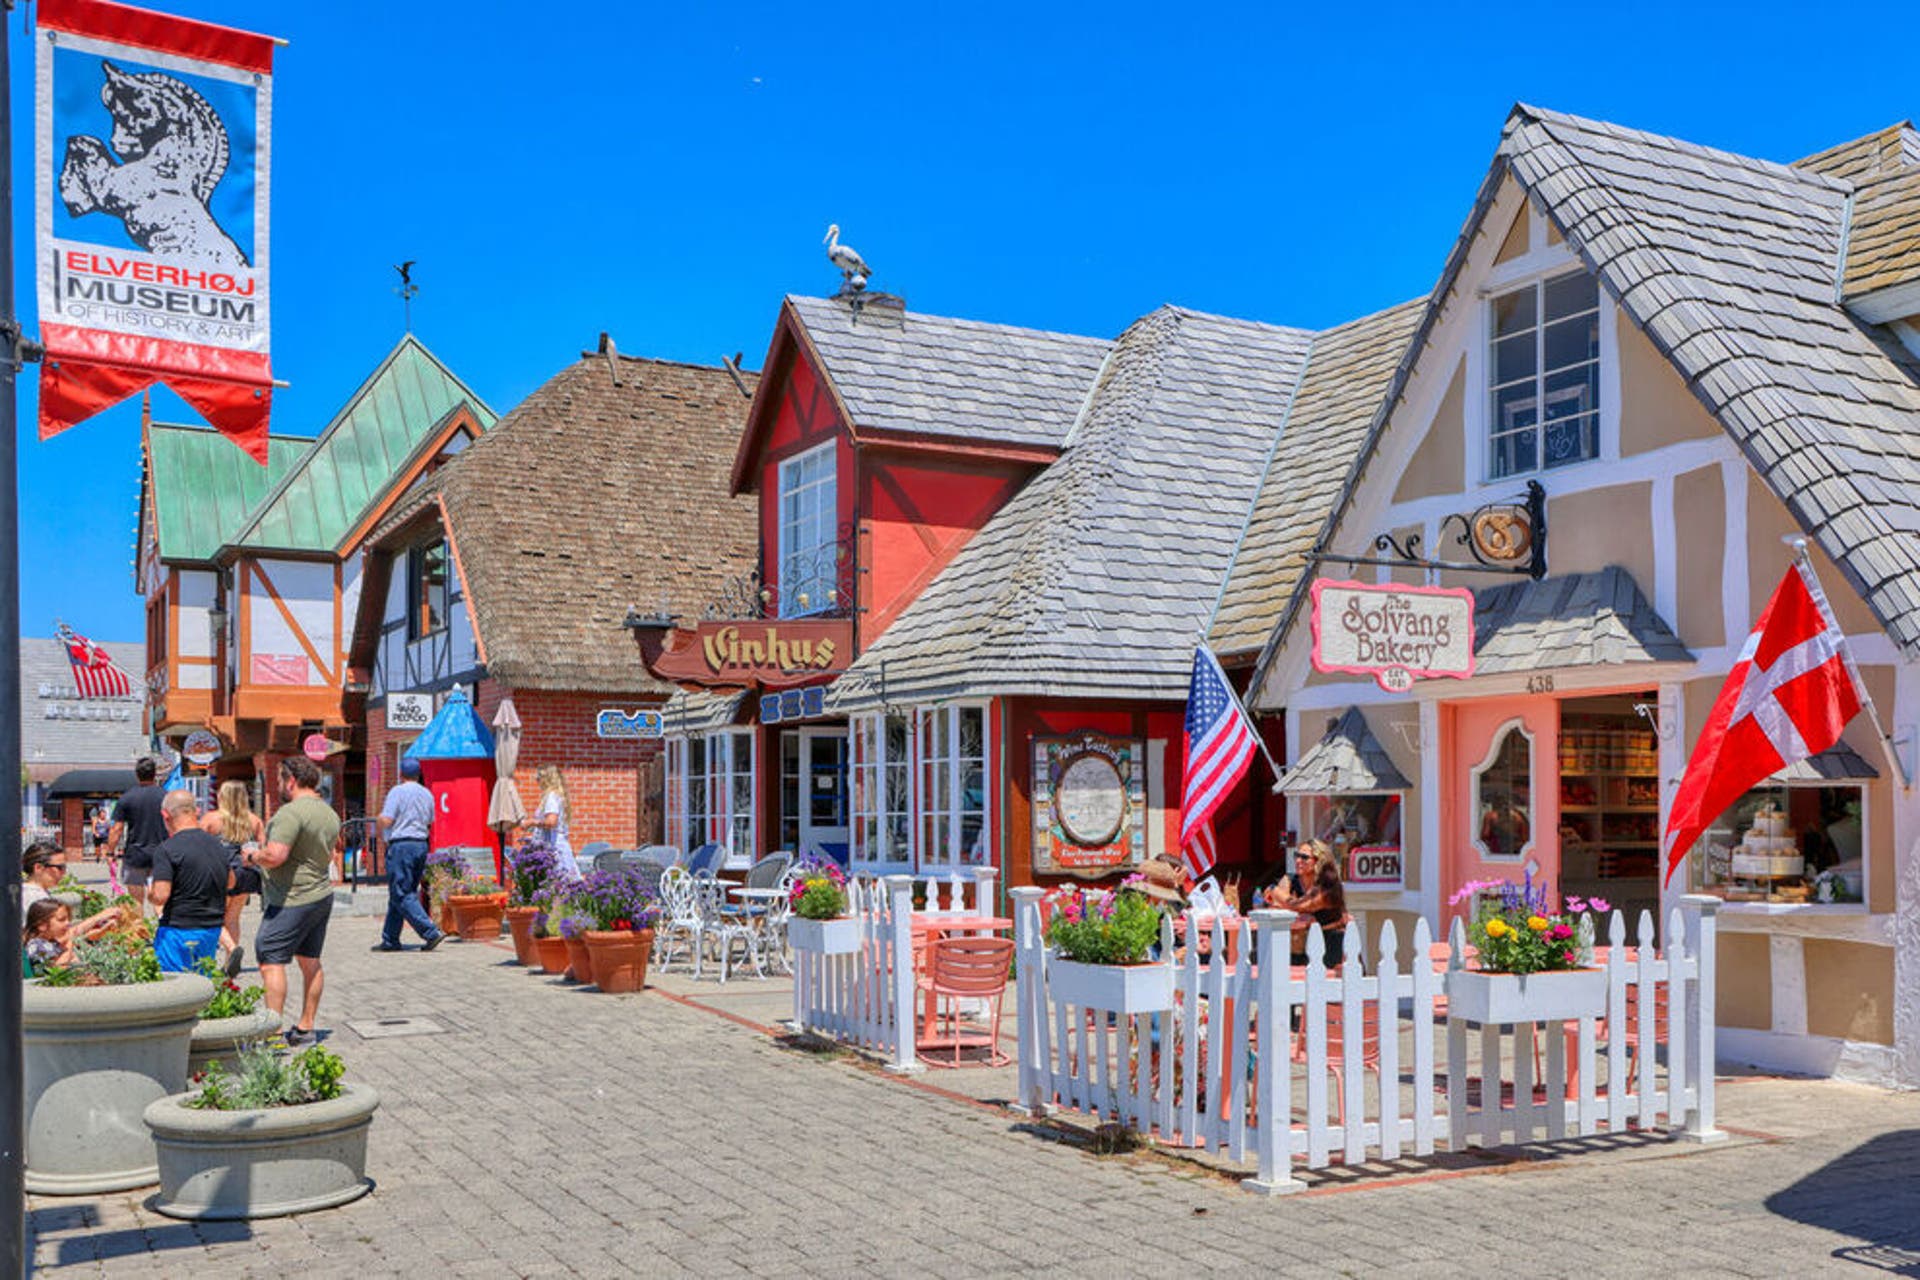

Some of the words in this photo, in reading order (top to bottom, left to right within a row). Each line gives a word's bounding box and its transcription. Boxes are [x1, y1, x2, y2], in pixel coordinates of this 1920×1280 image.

[66, 251, 255, 297] ELVERHØJ
[67, 277, 255, 323] MUSEUM
[67, 303, 97, 318] OF
[104, 306, 192, 332] HISTORY
[195, 322, 209, 335] &
[215, 324, 255, 341] ART
[1342, 595, 1450, 647] Solvang
[1387, 594, 1411, 610] The
[703, 626, 836, 670] Vinhus
[1357, 632, 1437, 671] Bakery
[1526, 675, 1554, 694] 438
[1357, 854, 1401, 876] OPEN
